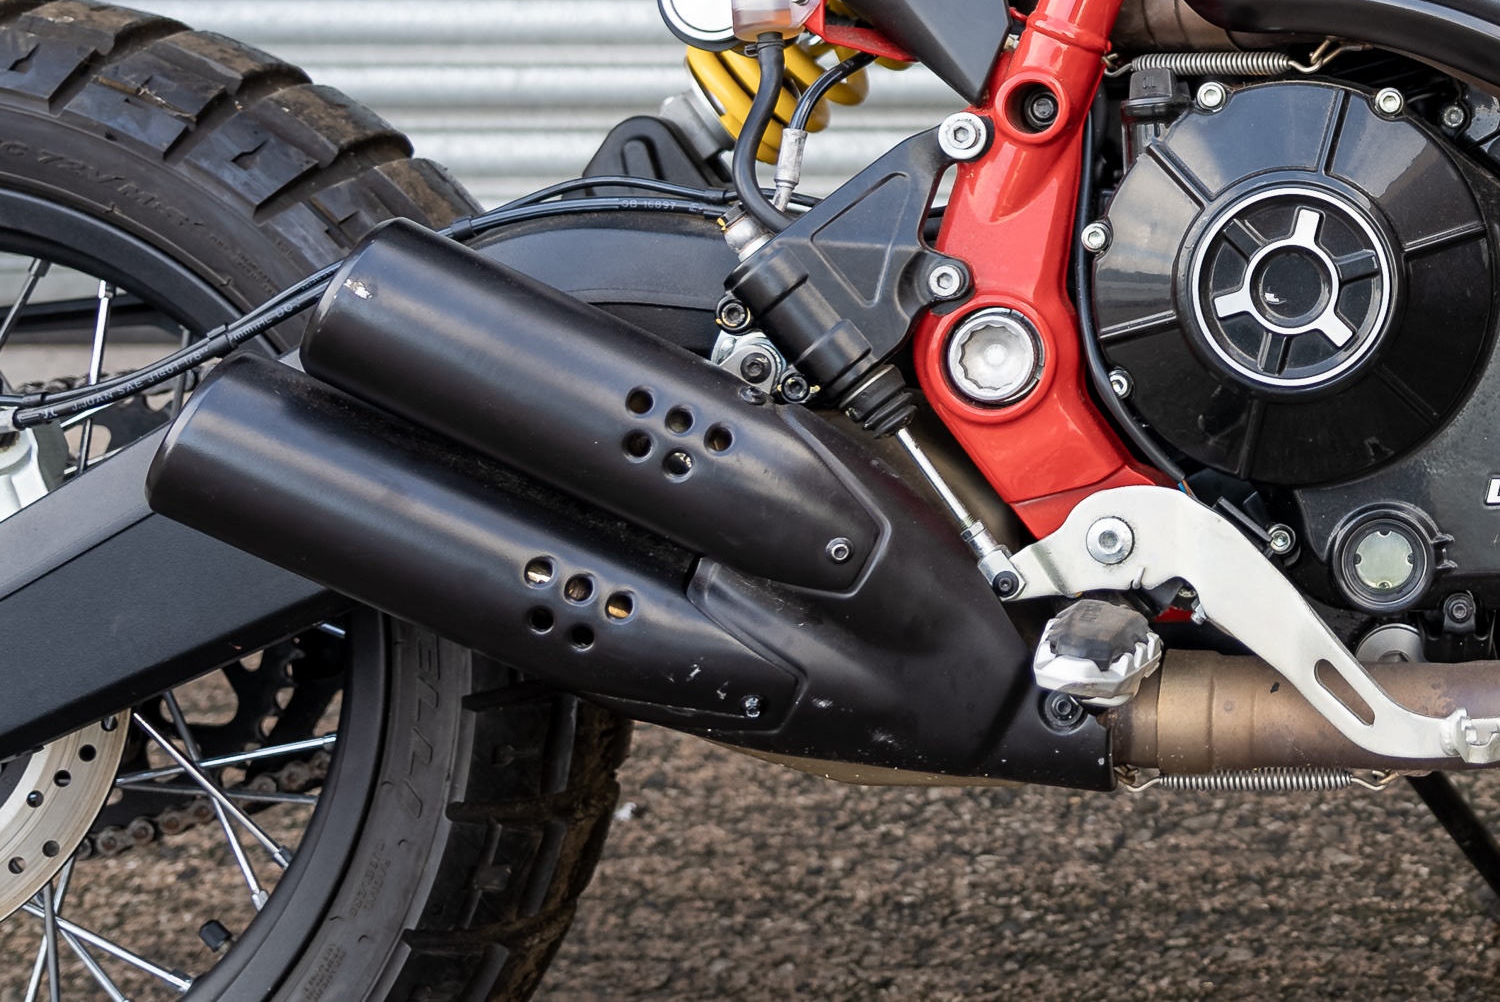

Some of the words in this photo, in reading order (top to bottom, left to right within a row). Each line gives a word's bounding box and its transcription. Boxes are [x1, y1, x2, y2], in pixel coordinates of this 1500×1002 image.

[71, 391, 115, 411] J.JUAN
[119, 380, 145, 395] SAE
[149, 364, 181, 383] J1401
